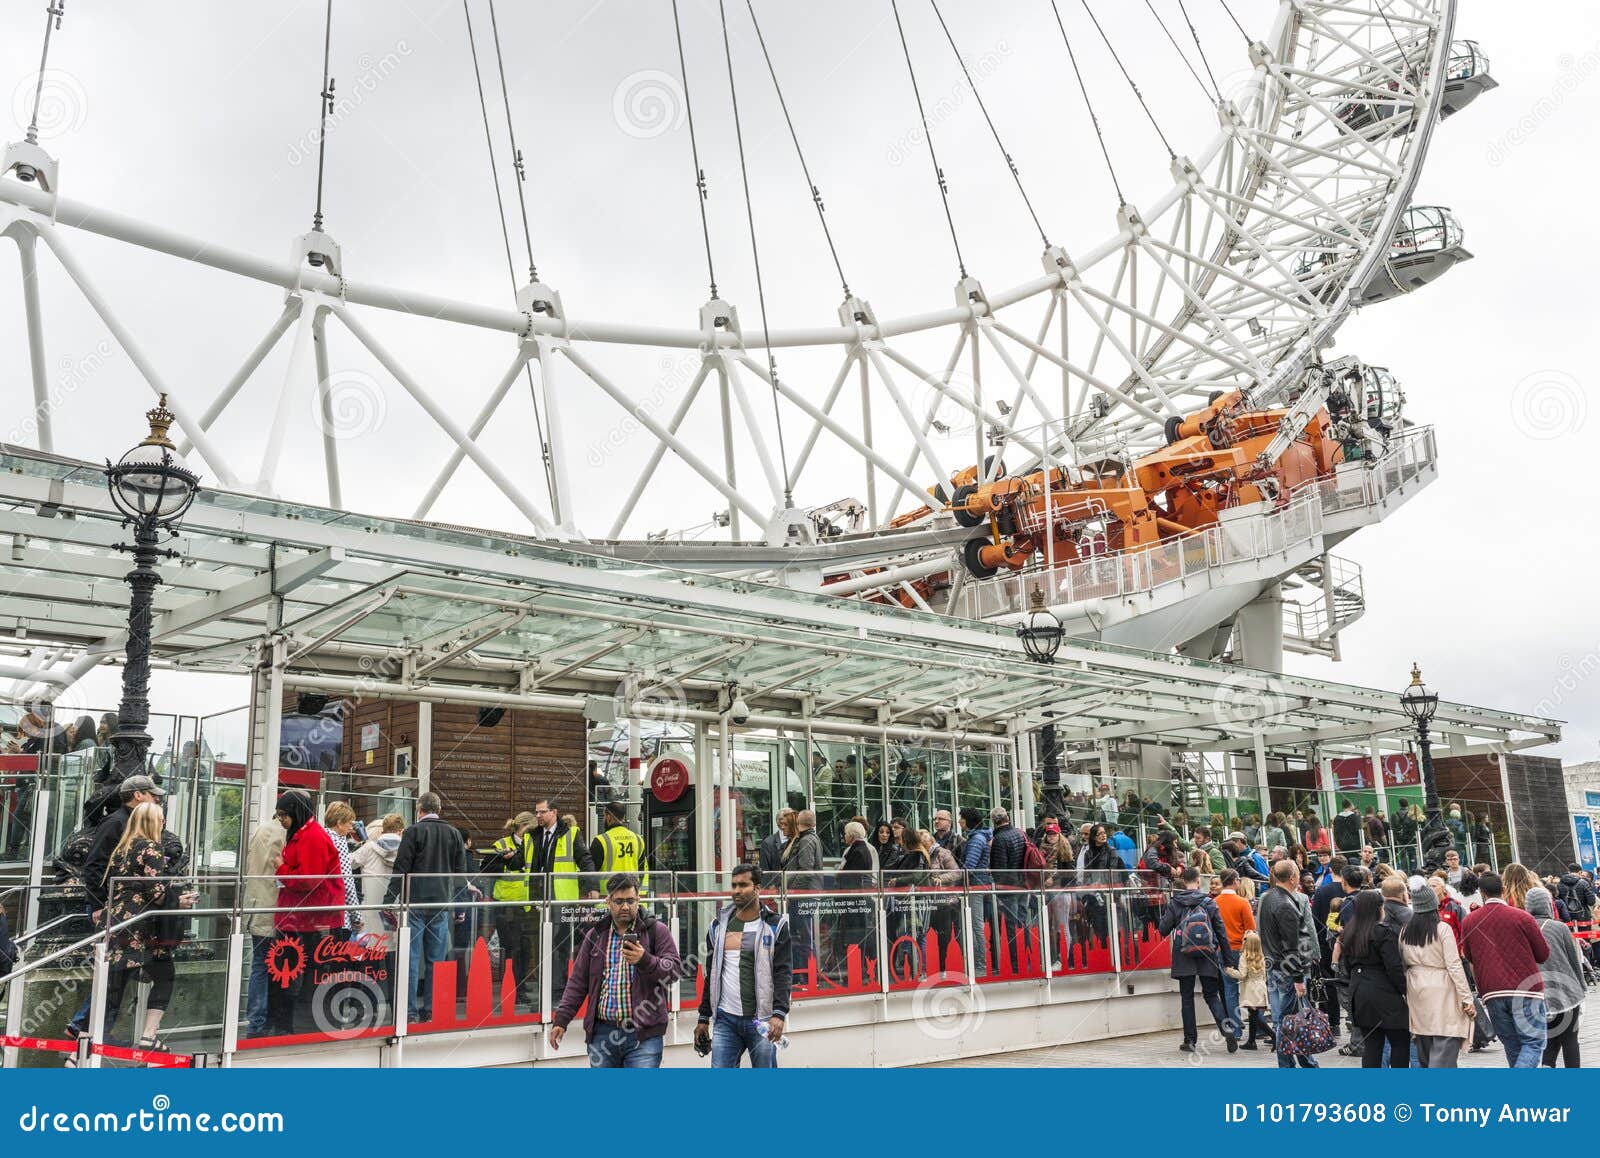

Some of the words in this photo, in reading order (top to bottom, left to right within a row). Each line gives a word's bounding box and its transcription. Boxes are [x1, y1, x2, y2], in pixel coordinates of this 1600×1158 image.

[617, 842, 634, 858] 34
[314, 968, 362, 984] London
[364, 966, 388, 985] Eye
